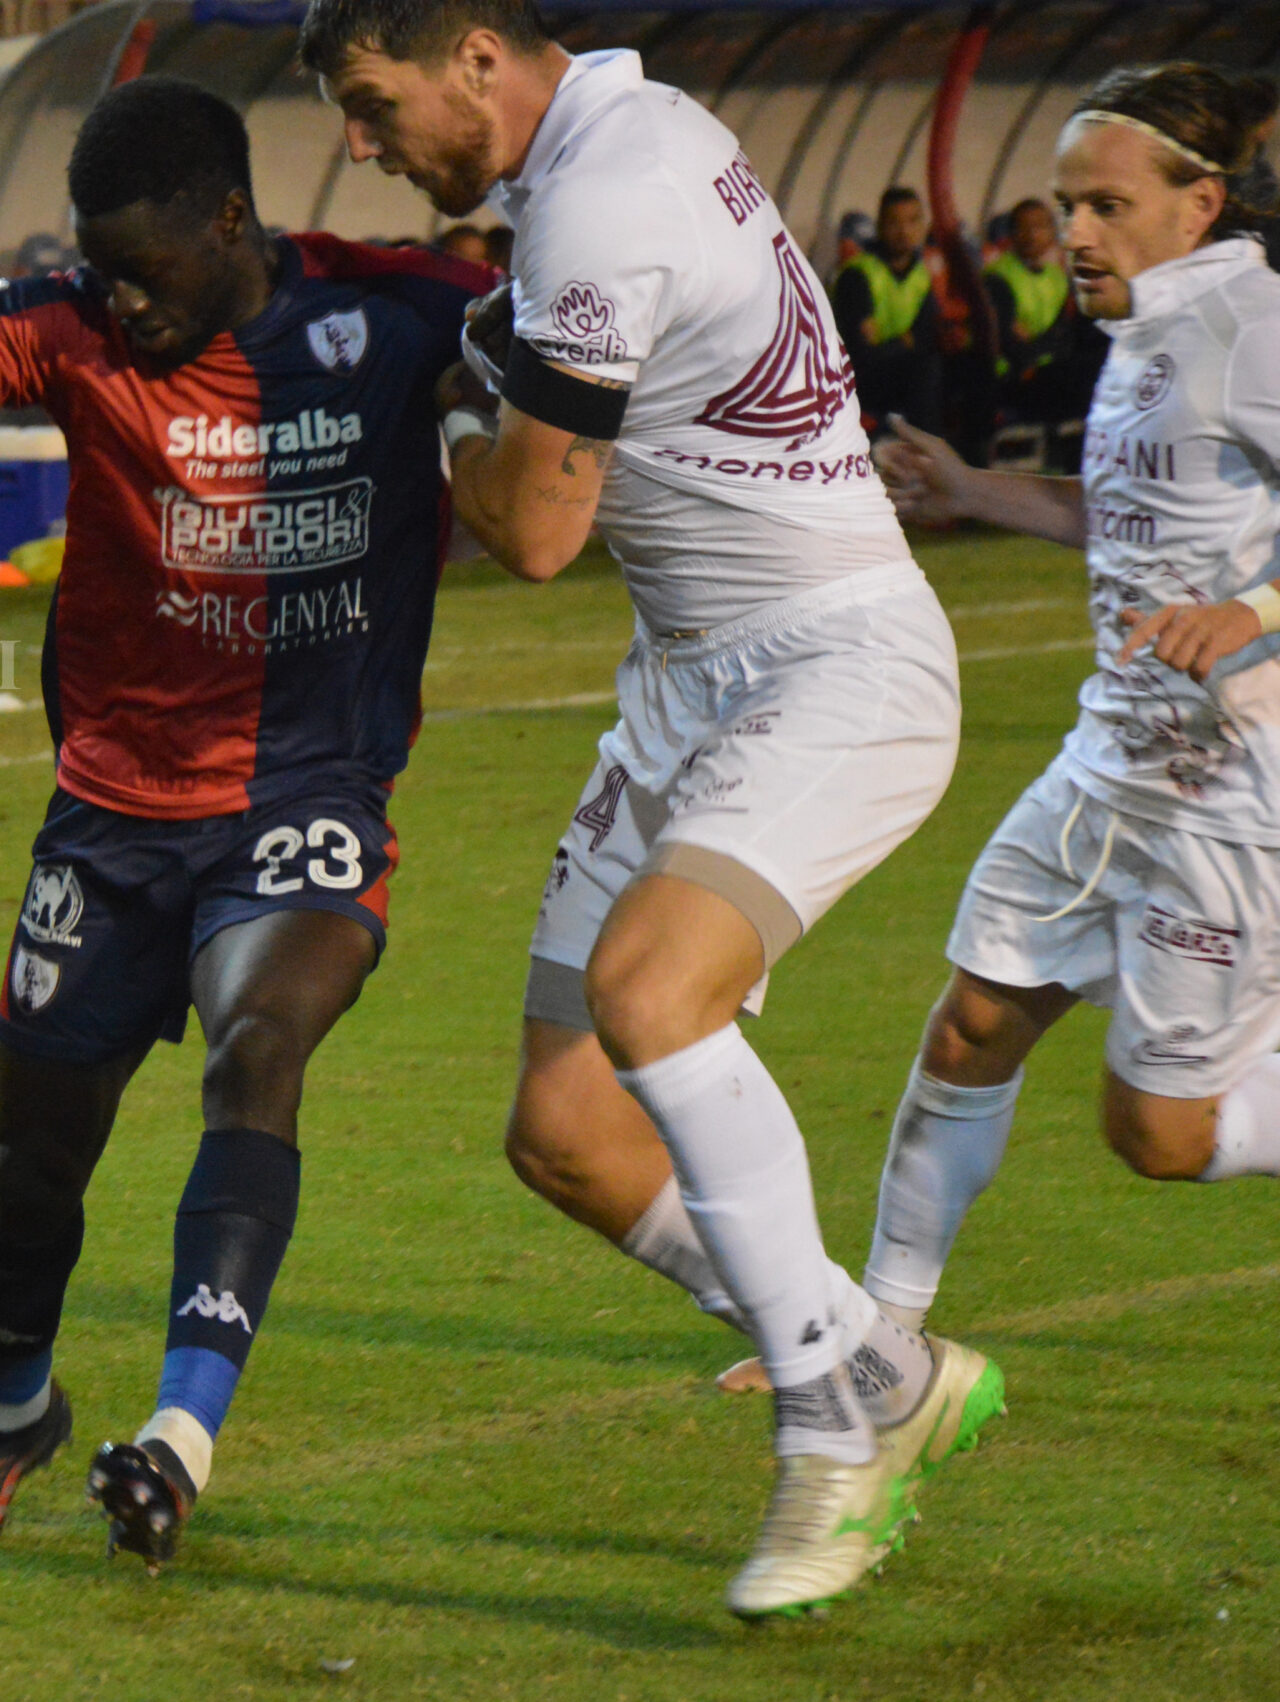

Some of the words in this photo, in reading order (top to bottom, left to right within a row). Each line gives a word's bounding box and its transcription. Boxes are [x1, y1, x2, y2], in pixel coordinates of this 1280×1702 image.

[166, 408, 363, 458] Sideralba
[186, 459, 217, 480] The
[221, 459, 265, 479] steel
[269, 457, 301, 480] you
[306, 448, 349, 472] need
[171, 497, 337, 531] GIUDICI
[171, 515, 361, 554] POLIDORI
[201, 577, 369, 640] REGENYAL
[573, 765, 629, 852] 4
[252, 818, 363, 897] 23
